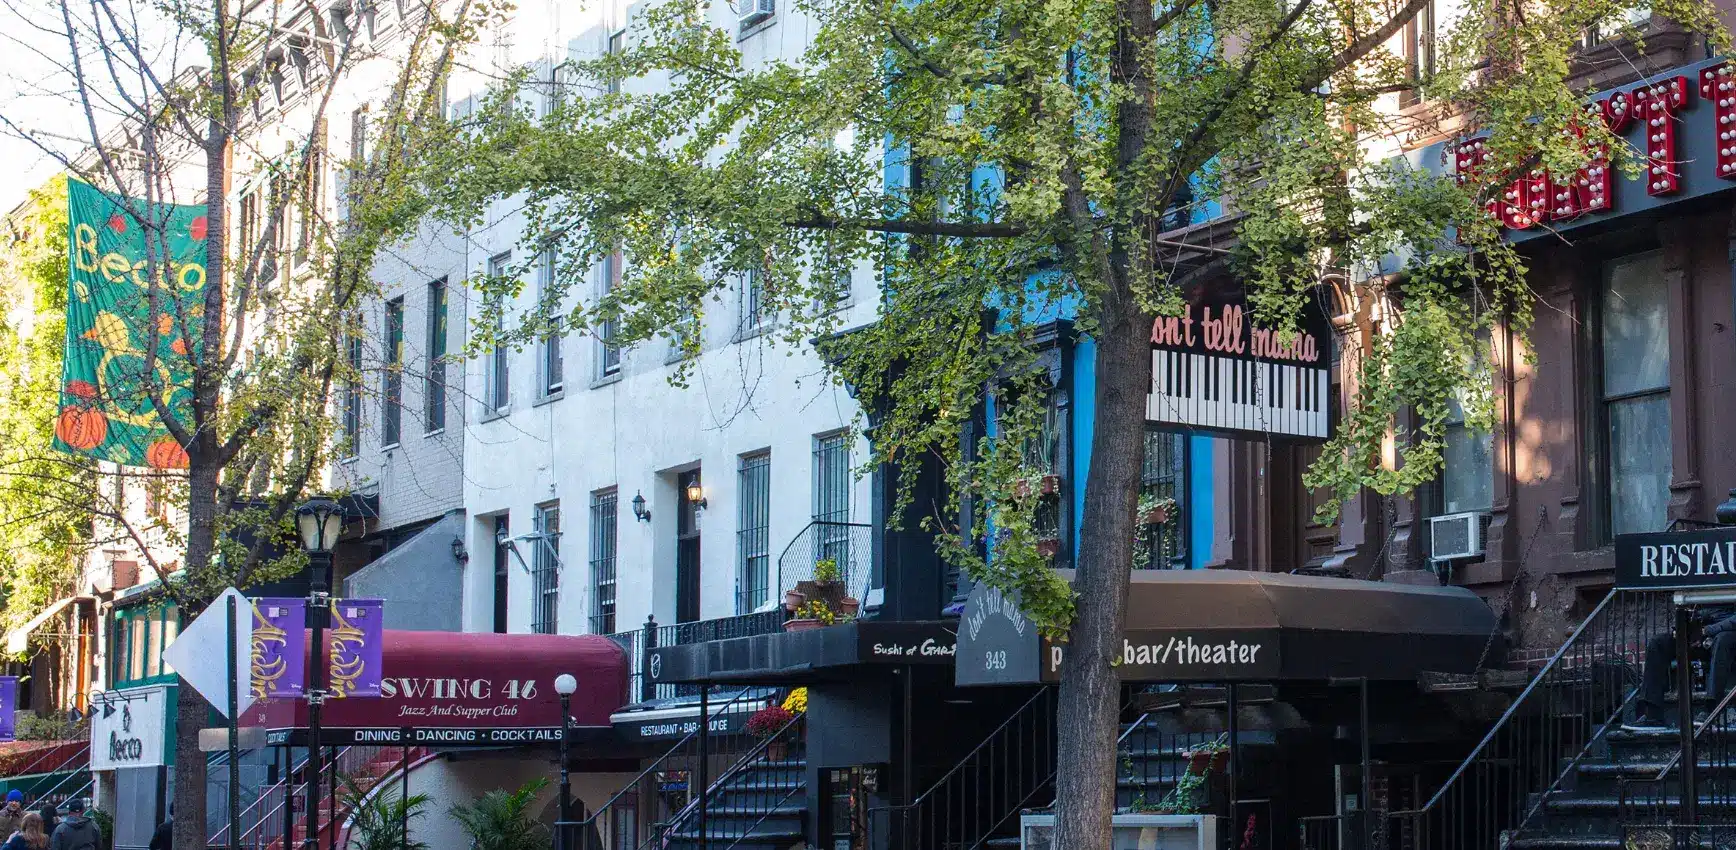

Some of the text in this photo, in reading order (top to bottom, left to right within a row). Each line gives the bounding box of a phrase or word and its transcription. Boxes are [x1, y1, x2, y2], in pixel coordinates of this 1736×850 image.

[75, 223, 207, 292] Becco
[1150, 304, 1196, 347] ont
[1201, 304, 1246, 355] tell
[873, 643, 902, 655] Sushi
[1124, 635, 1262, 665] bar/theater
[985, 650, 1007, 670] 343
[381, 677, 538, 700] SWING 46
[398, 704, 518, 719] Jazz And Supper Club
[355, 729, 563, 741] DINING DANCING COCKTAILS
[640, 719, 728, 736] RESTAURANT BAR UNGE
